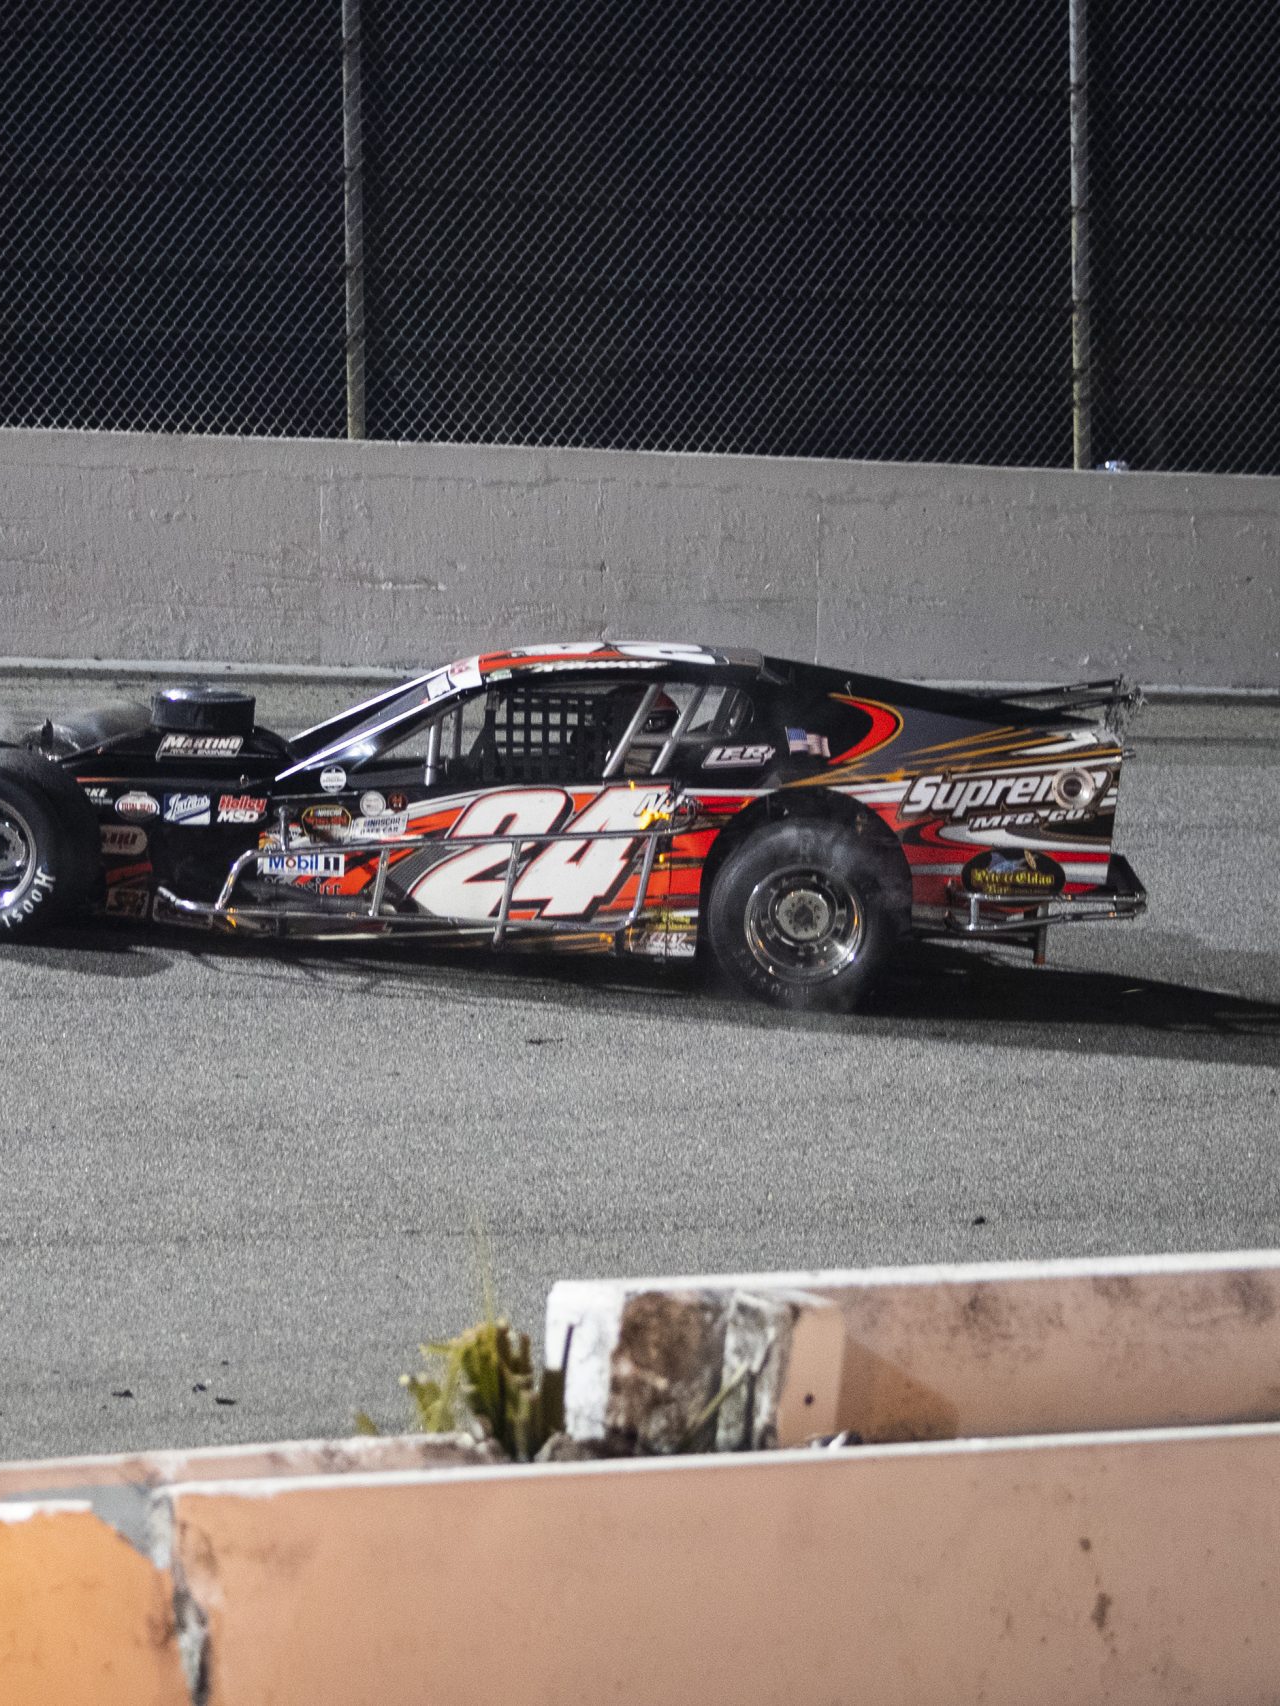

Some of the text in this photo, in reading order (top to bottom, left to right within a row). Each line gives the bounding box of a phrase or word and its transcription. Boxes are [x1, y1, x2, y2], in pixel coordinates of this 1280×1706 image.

[902, 769, 1109, 818] Supre
[218, 794, 267, 811] Holley
[217, 811, 259, 823] MSD
[408, 785, 673, 920] 24
[268, 853, 319, 870] Mobil
